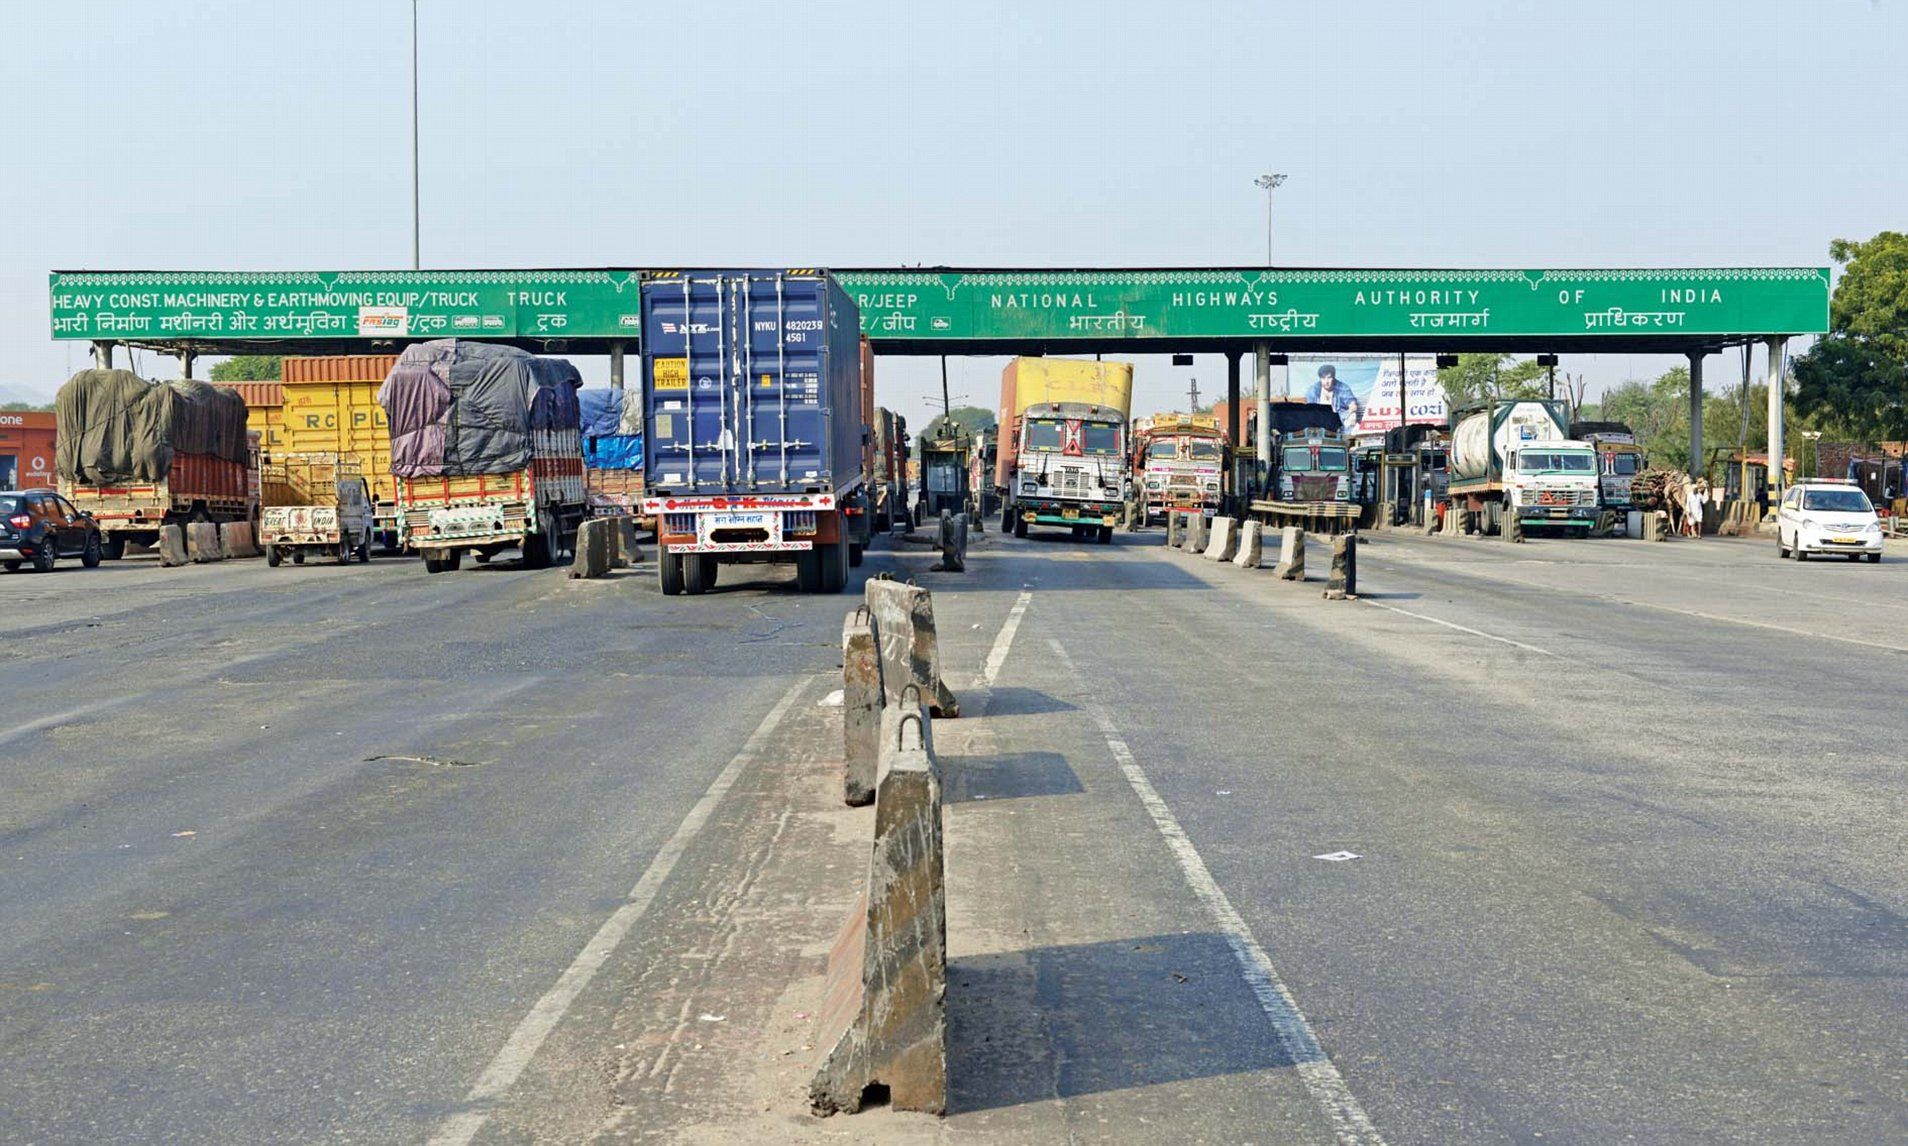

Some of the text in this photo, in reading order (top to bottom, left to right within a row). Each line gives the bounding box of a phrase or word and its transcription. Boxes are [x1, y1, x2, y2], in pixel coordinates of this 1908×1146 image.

[53, 294, 105, 309] HEAVY
[164, 293, 251, 308] MACHINERY
[253, 294, 265, 307] &
[267, 292, 373, 307] EARTHMOVING
[508, 291, 567, 307] TRUCK
[991, 289, 1722, 308] NATIONAL HIGHWAYS AUTHORITY OF INDIA
[53, 312, 89, 331] भारी
[95, 312, 152, 331] निर्माण
[159, 312, 223, 331] मशीनरी
[229, 311, 258, 331] और
[536, 314, 568, 332] ट्रक
[755, 322, 777, 332] NYKU
[1069, 306, 1687, 332] भारतीय राष्ट्रीय राजमार्ग प्राधिकरण
[655, 361, 686, 369] CAUTION
[663, 370, 680, 378] HIGH
[657, 378, 687, 387] TRAILER
[1410, 402, 1443, 416] cozi
